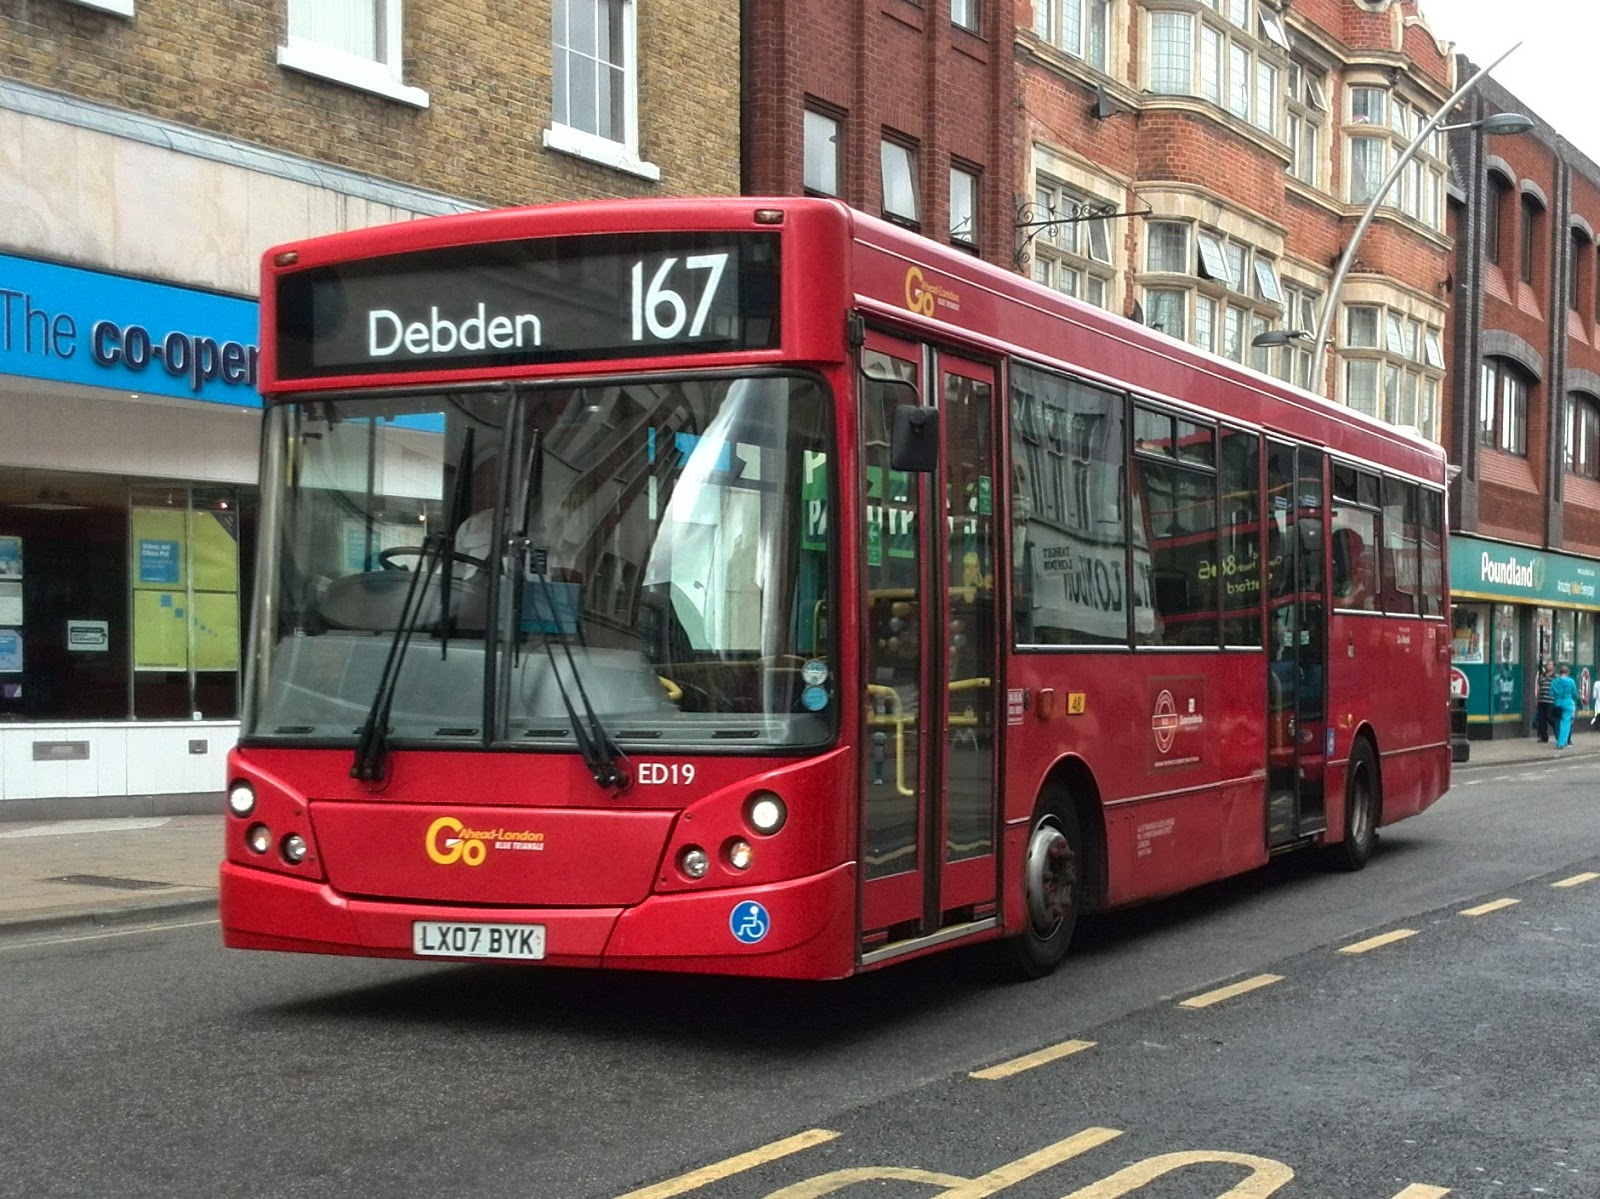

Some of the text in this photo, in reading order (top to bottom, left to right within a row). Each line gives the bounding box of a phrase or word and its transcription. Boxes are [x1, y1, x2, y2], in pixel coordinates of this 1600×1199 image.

[631, 253, 730, 341] 167
[0, 288, 77, 359] The
[368, 302, 542, 356] Debden
[1481, 551, 1533, 588] Poundland
[638, 763, 695, 785] ED19
[425, 816, 487, 867] Go
[421, 925, 534, 955] LX07 BYK
